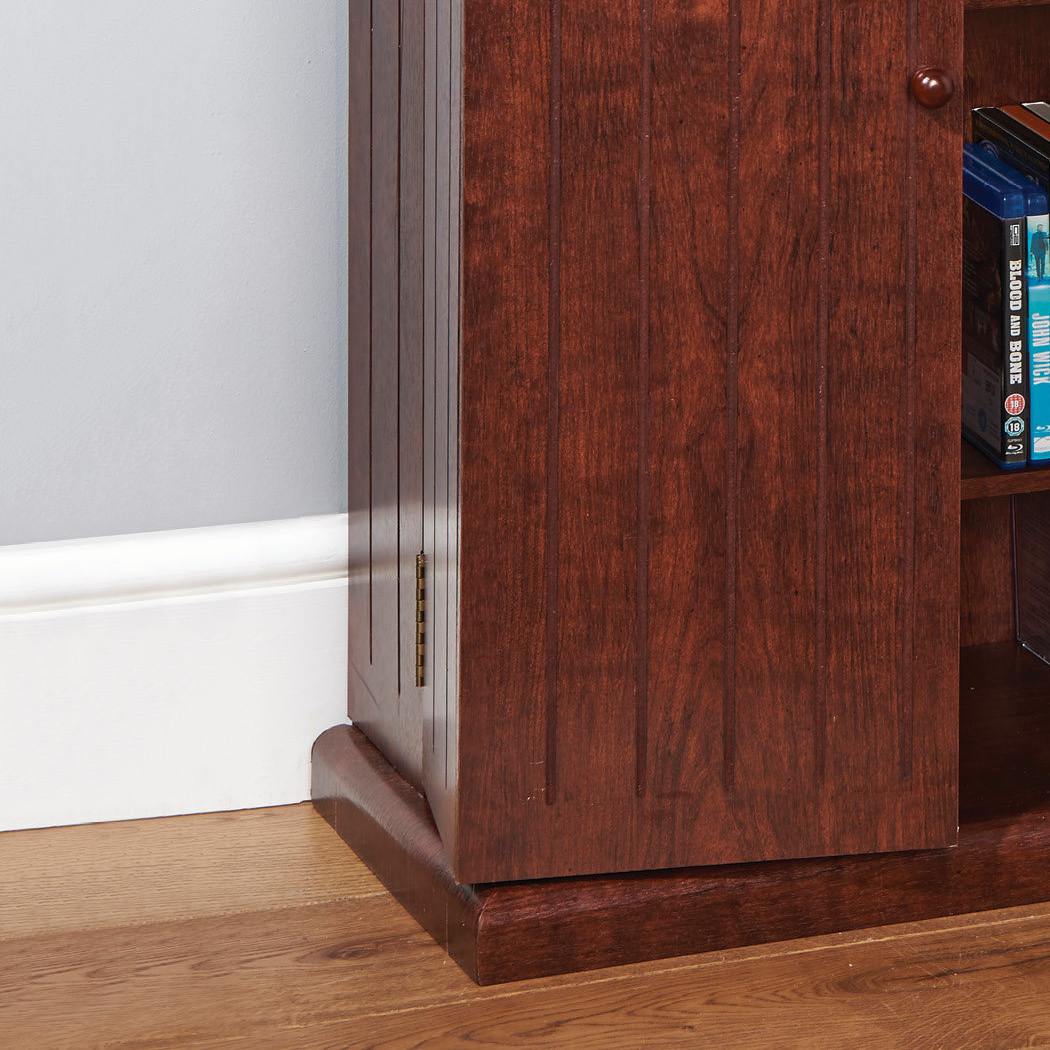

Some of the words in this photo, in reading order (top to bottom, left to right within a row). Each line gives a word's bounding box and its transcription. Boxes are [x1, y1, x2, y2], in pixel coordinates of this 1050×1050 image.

[1009, 259, 1022, 311] BLOOD
[1010, 314, 1020, 337] AND
[1031, 313, 1050, 347] JOHN
[1009, 340, 1022, 385] BONE
[1032, 351, 1050, 385] WICK
